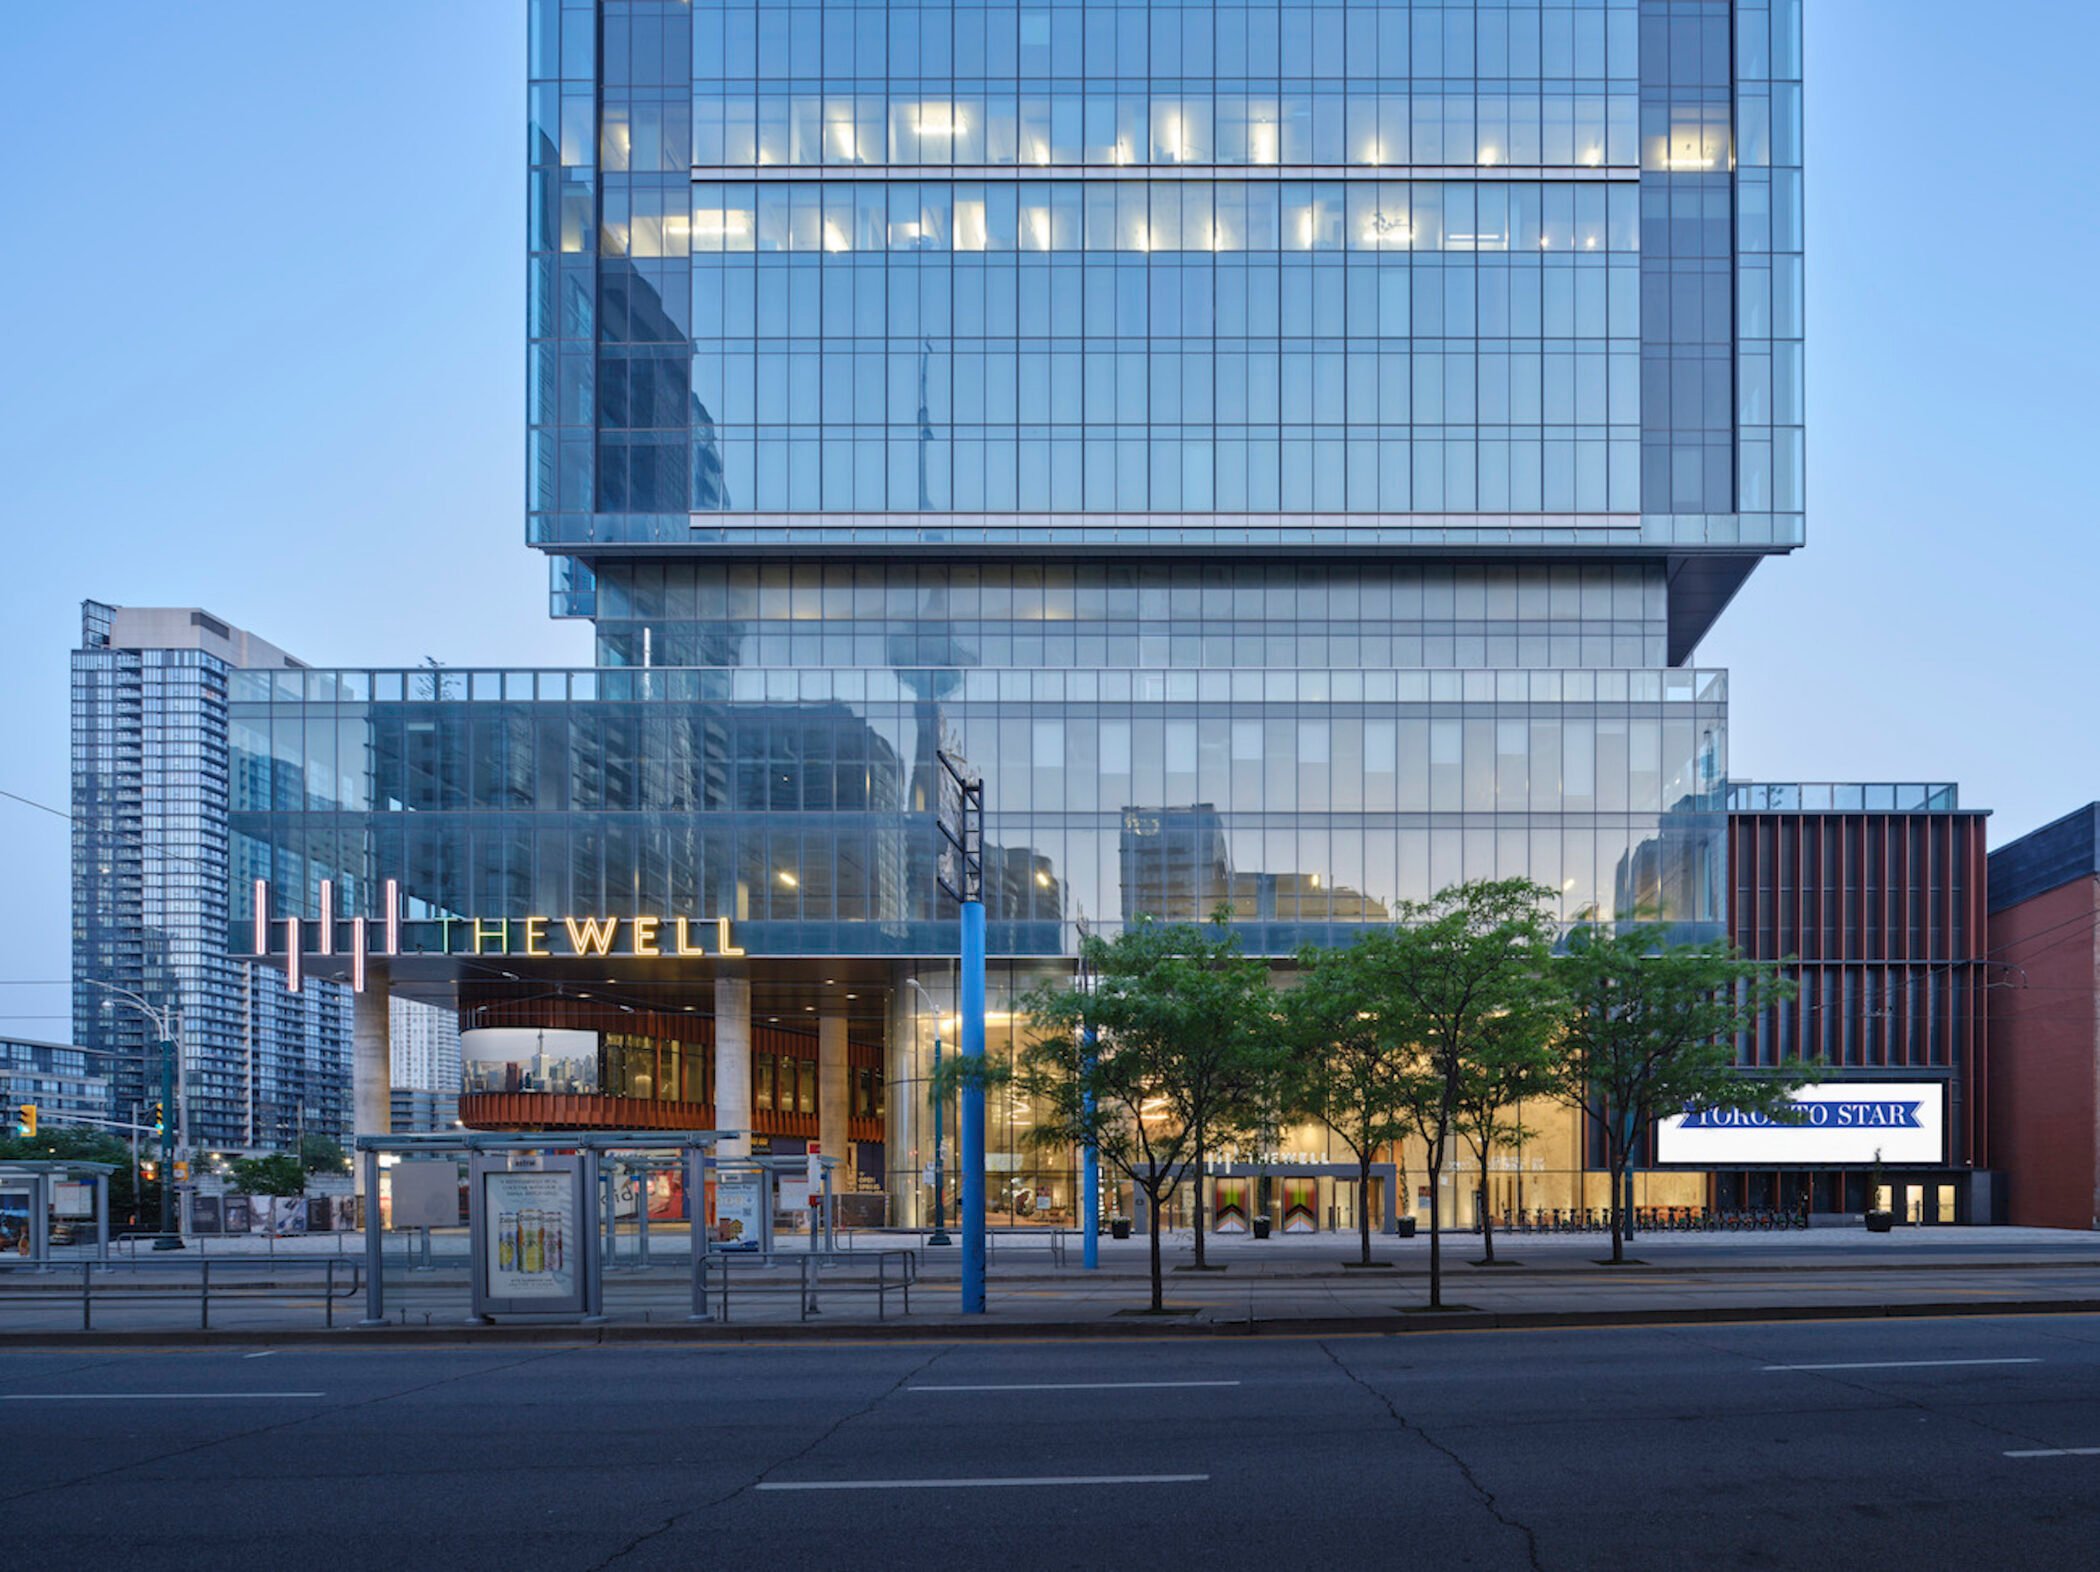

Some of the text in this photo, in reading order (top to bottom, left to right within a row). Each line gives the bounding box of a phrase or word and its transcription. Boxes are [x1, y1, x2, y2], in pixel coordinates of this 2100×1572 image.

[434, 916, 745, 956] THE WELL
[1837, 1104, 1906, 1125] STAR
[1281, 1152, 1330, 1165] WELL
